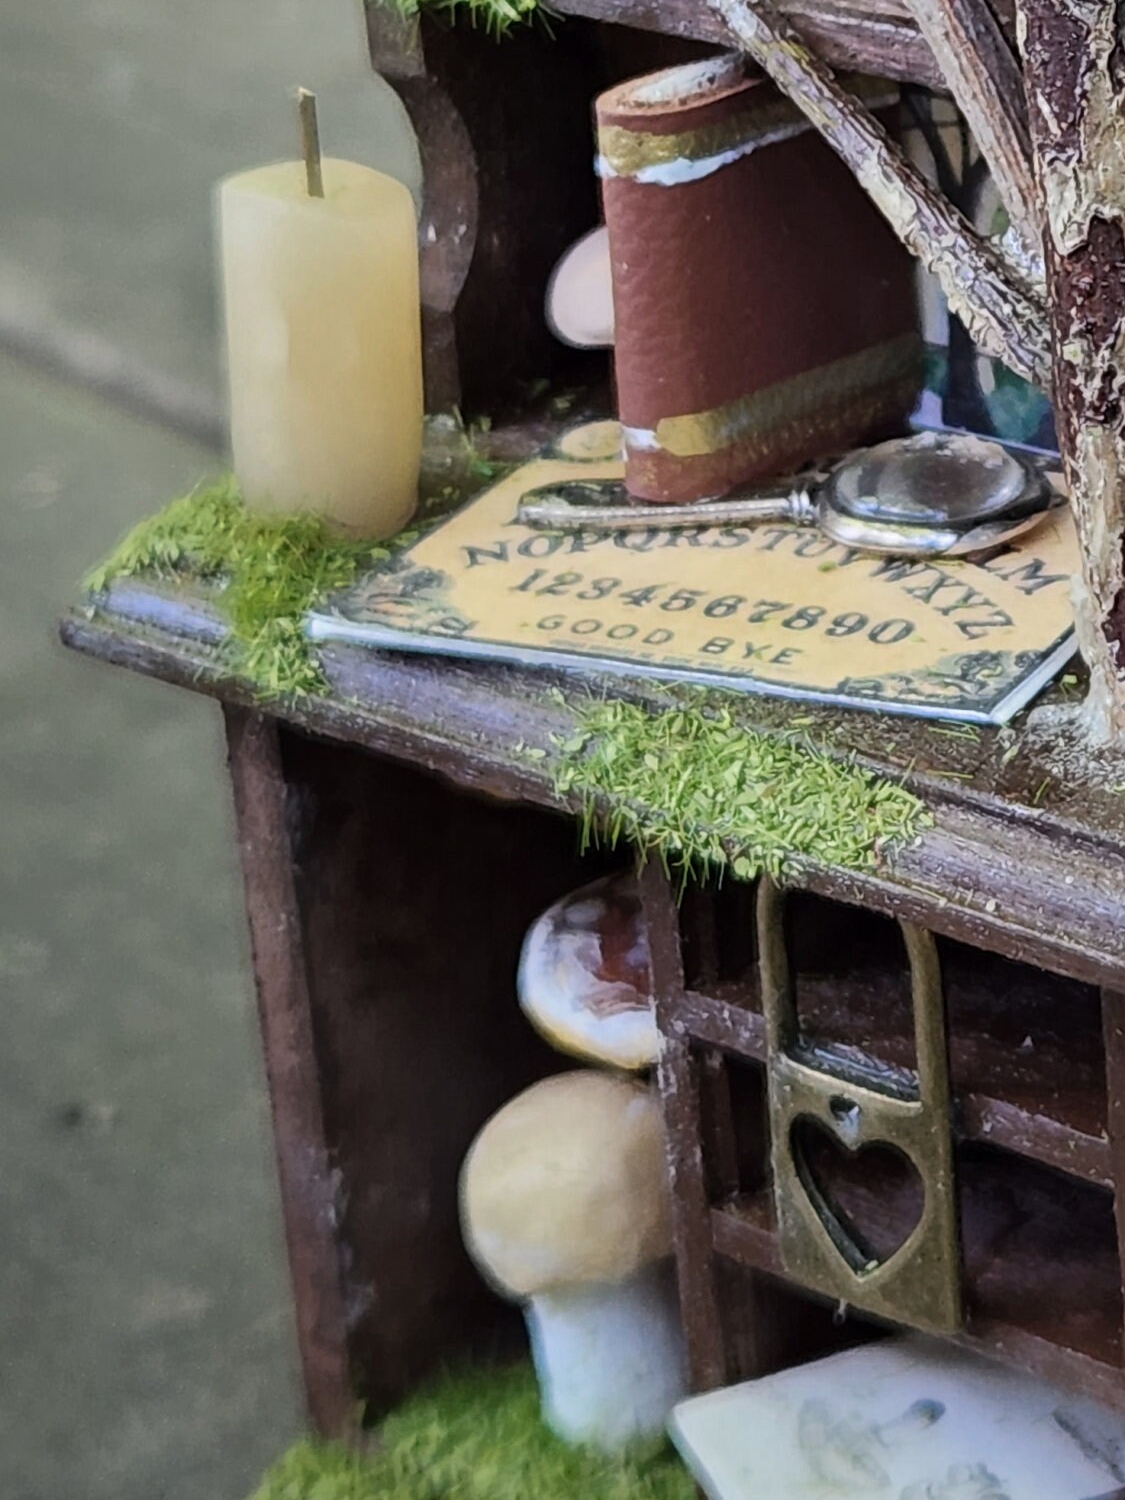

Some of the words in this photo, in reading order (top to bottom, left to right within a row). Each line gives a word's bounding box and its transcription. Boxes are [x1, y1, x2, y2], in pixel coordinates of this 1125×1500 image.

[508, 568, 915, 645] 1234567890
[536, 614, 675, 645] GOOD
[698, 636, 802, 666] BYE
